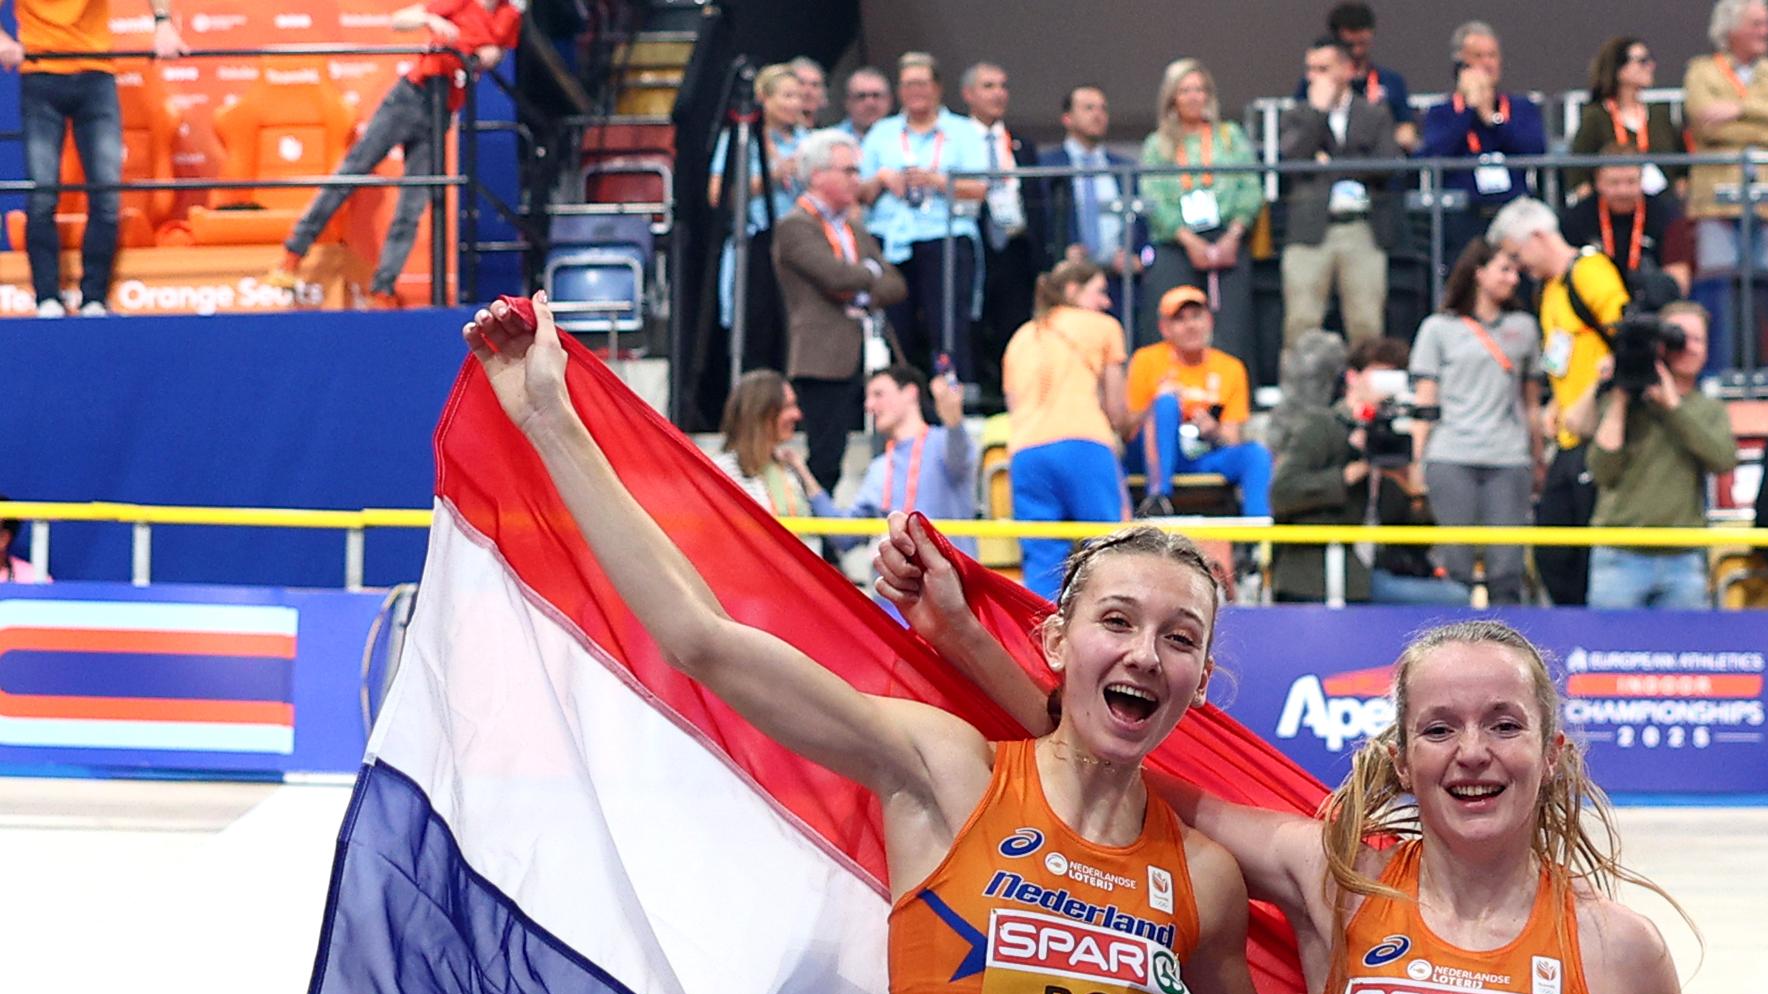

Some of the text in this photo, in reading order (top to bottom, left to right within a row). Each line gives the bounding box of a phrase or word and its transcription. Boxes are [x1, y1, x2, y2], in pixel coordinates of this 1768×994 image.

[119, 280, 234, 316] Orange
[1588, 650, 1765, 672] EUROPEAN ATHLETICS
[1616, 675, 1712, 697] INDOOR
[1565, 699, 1765, 726] CHAMPIONSHIPS
[1617, 725, 1710, 748] 2025
[1068, 870, 1114, 891] LOTERIJ
[1069, 861, 1137, 889] NEDERLANDSE
[998, 922, 1146, 978] SPAR
[1432, 974, 1483, 989] LOTERIJ
[1434, 966, 1511, 985] NEDERLANDSE
